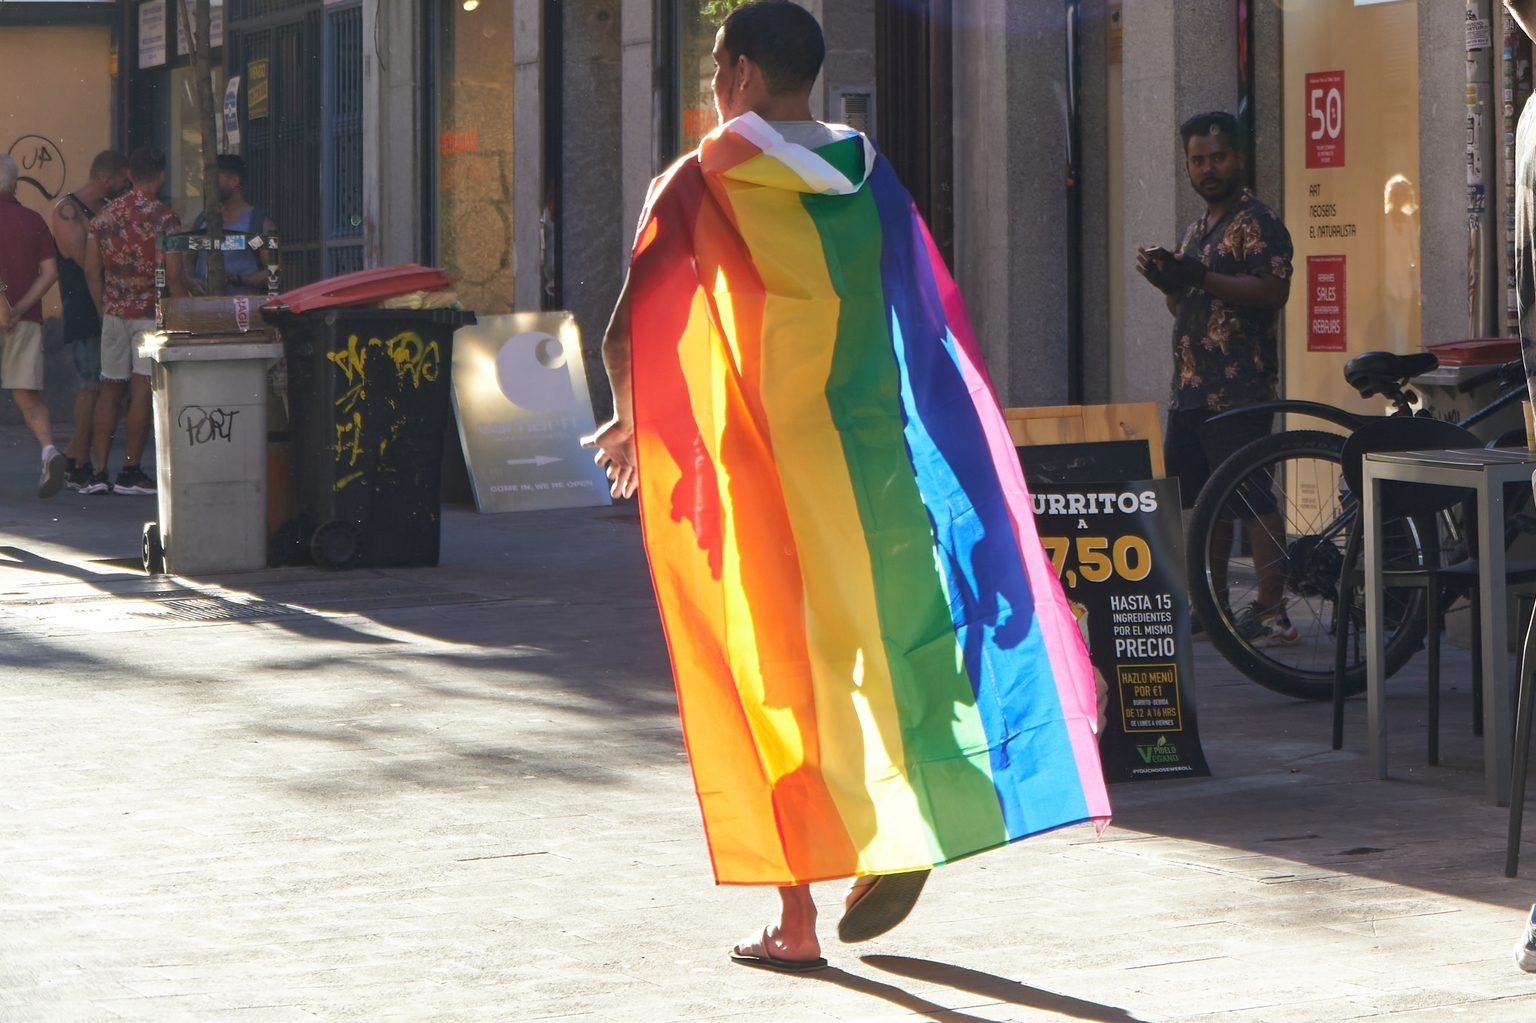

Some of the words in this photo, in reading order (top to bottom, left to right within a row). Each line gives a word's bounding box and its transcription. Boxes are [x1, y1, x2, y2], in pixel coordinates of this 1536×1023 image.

[1308, 203, 1337, 218] NEOSENS
[1308, 225, 1316, 239] EL
[1317, 223, 1357, 239] NATURALISTA
[1316, 286, 1337, 301] SALES
[1312, 319, 1341, 334] REBAJAS
[490, 484, 518, 492] COME
[566, 479, 593, 488] OPEN
[1029, 491, 1158, 515] URRITOS
[1077, 519, 1088, 529] A
[1110, 595, 1152, 611] HASTA
[1155, 594, 1172, 610] 15
[1113, 612, 1172, 623] INGREDIENTES
[1113, 625, 1131, 636] POR
[1132, 625, 1143, 636] EL
[1144, 624, 1173, 635] MISMO
[1115, 637, 1175, 658] PRECIO
[1121, 672, 1148, 684] HAZLO
[1149, 669, 1174, 683] MENÚ
[1134, 686, 1151, 697] POR
[1152, 685, 1163, 696] €1
[1125, 708, 1135, 718] DE
[1136, 708, 1144, 718] 12
[1147, 708, 1153, 718] A
[1153, 708, 1161, 717] 16
[1162, 707, 1177, 717] HRS
